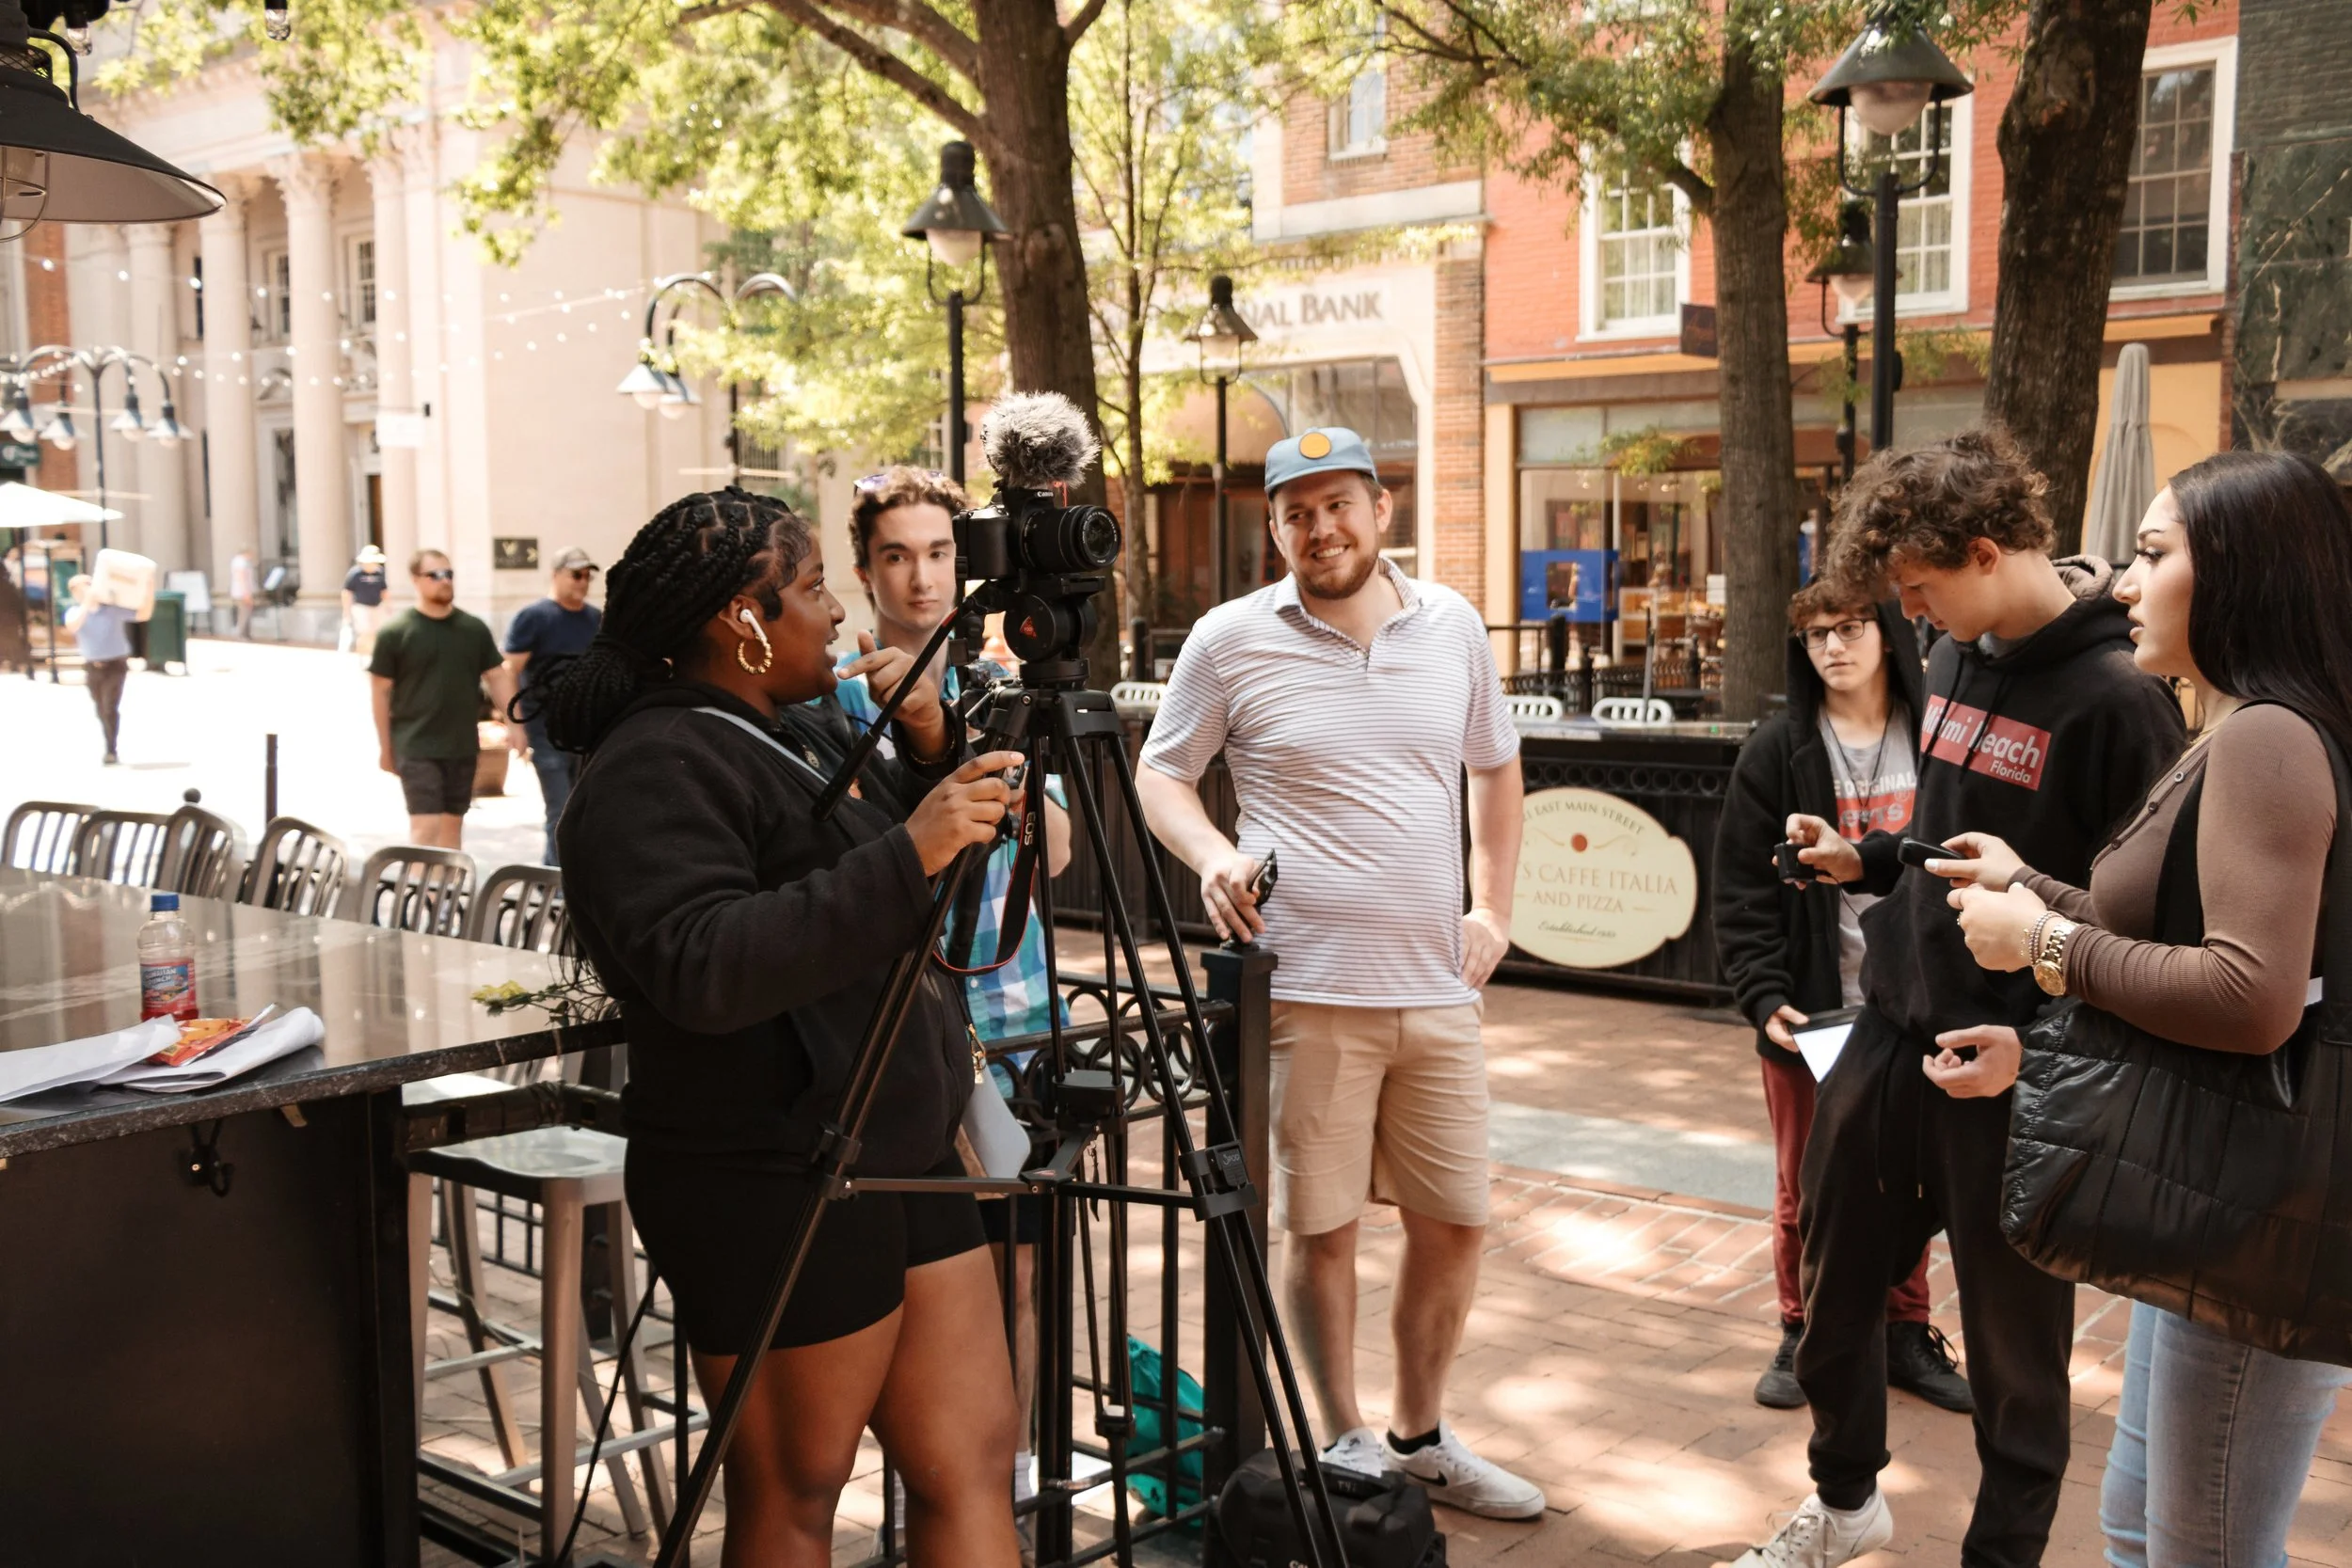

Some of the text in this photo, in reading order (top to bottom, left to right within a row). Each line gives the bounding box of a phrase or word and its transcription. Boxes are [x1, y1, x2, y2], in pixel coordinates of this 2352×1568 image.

[1300, 291, 1384, 324] BANK
[1990, 760, 2032, 784] Florida
[1025, 811, 1036, 846] EOS
[1534, 800, 1561, 816] EAST
[1565, 800, 1599, 815] MAIN
[1601, 806, 1645, 835] STREET
[1538, 863, 1600, 888] CAFFE
[1609, 871, 1678, 895] ITALIA
[1533, 890, 1624, 913] AND PIZZA
[1537, 920, 1597, 938] Established
